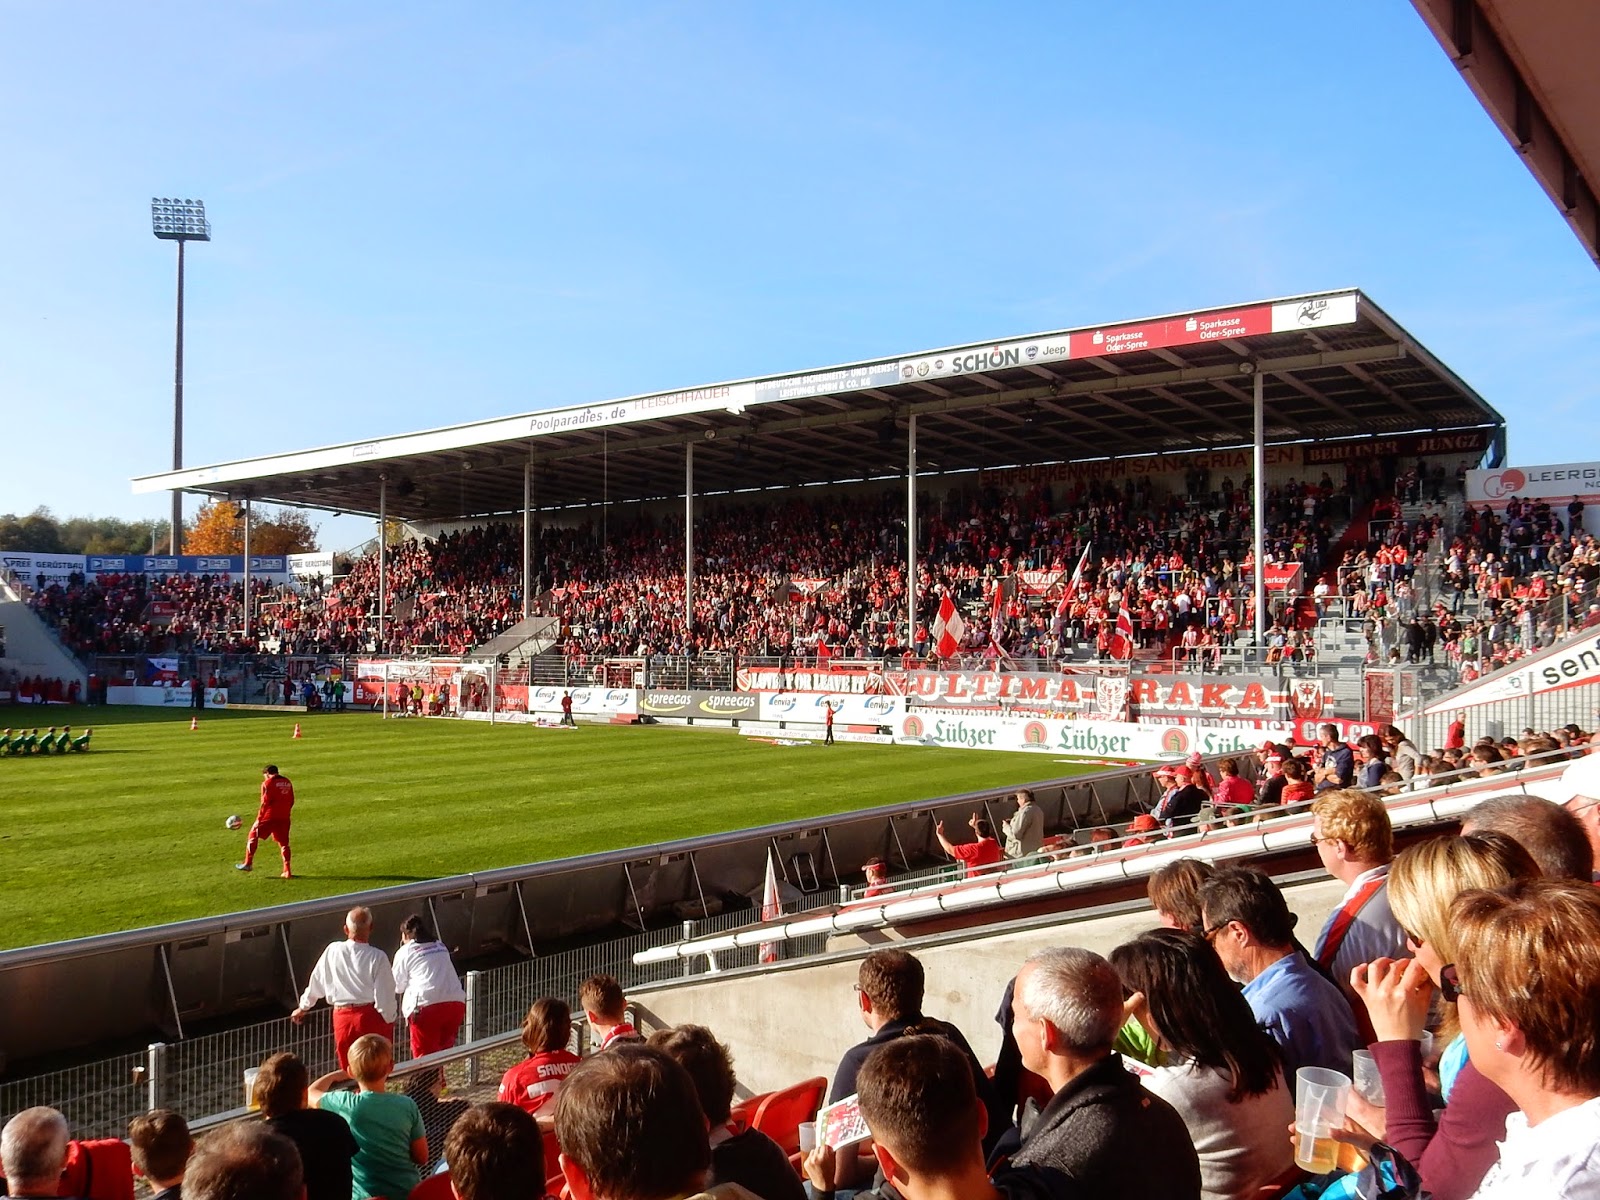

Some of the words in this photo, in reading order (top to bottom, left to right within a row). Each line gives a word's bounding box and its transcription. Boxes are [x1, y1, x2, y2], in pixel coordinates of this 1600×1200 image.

[1200, 317, 1241, 330] Sparkasse
[1106, 331, 1143, 343] Sparkasse
[1200, 327, 1246, 340] Oder-Spree
[1043, 345, 1066, 356] Jeep
[1106, 340, 1149, 353] Oder-Spree
[850, 367, 867, 377] UND
[779, 385, 816, 398] LEISTUNGS
[634, 387, 730, 410] FLEISCHHAUER
[1310, 440, 1399, 460] BERLINER
[1417, 433, 1480, 452] JUNGZ
[1528, 468, 1600, 482] LEERG
[3, 557, 31, 568] SPREE
[36, 561, 84, 570] GERÜSTBAU
[1542, 639, 1600, 685] sen
[813, 673, 850, 692] LEAVE
[933, 719, 997, 747] Lübzer
[1057, 725, 1131, 755] Lübzer
